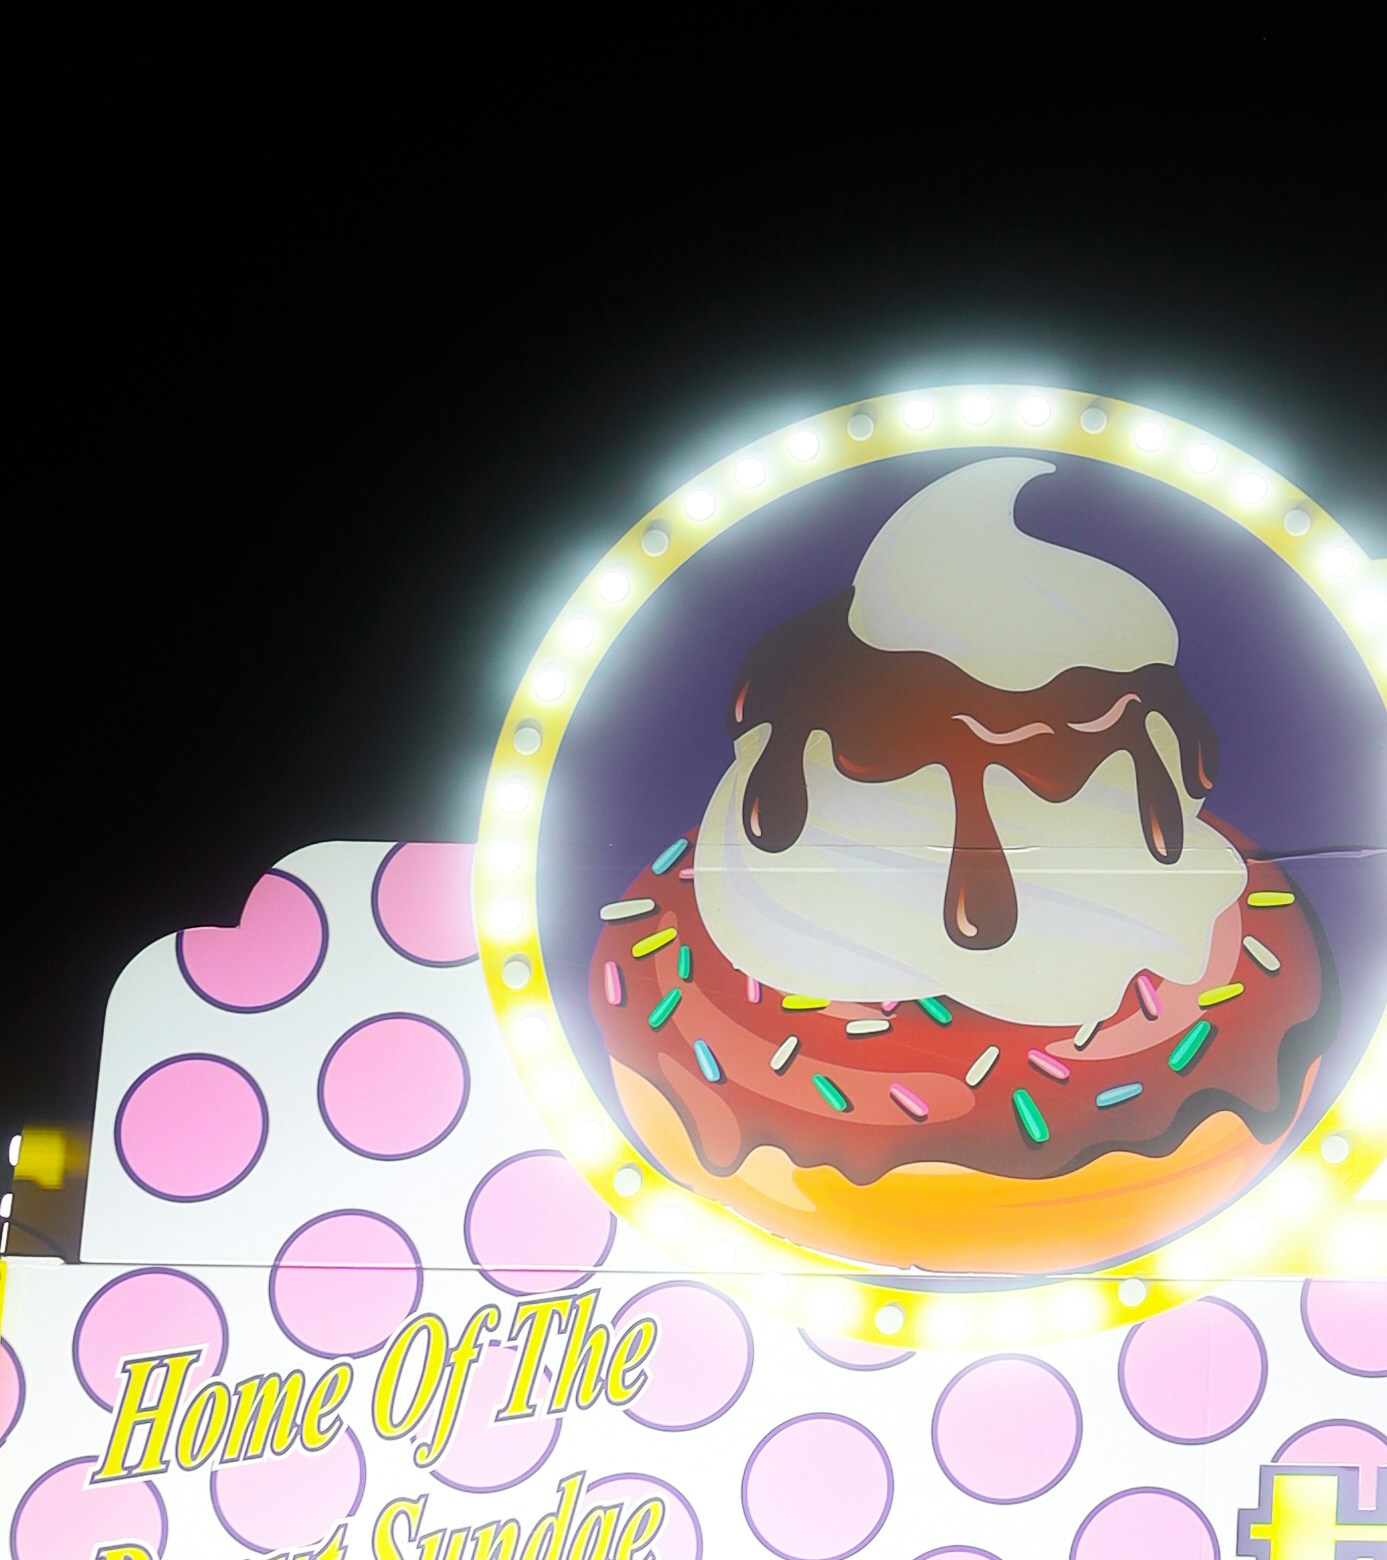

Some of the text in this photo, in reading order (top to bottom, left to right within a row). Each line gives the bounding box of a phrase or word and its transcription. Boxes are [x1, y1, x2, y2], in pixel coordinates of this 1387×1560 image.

[89, 1288, 658, 1483] Home Of The
